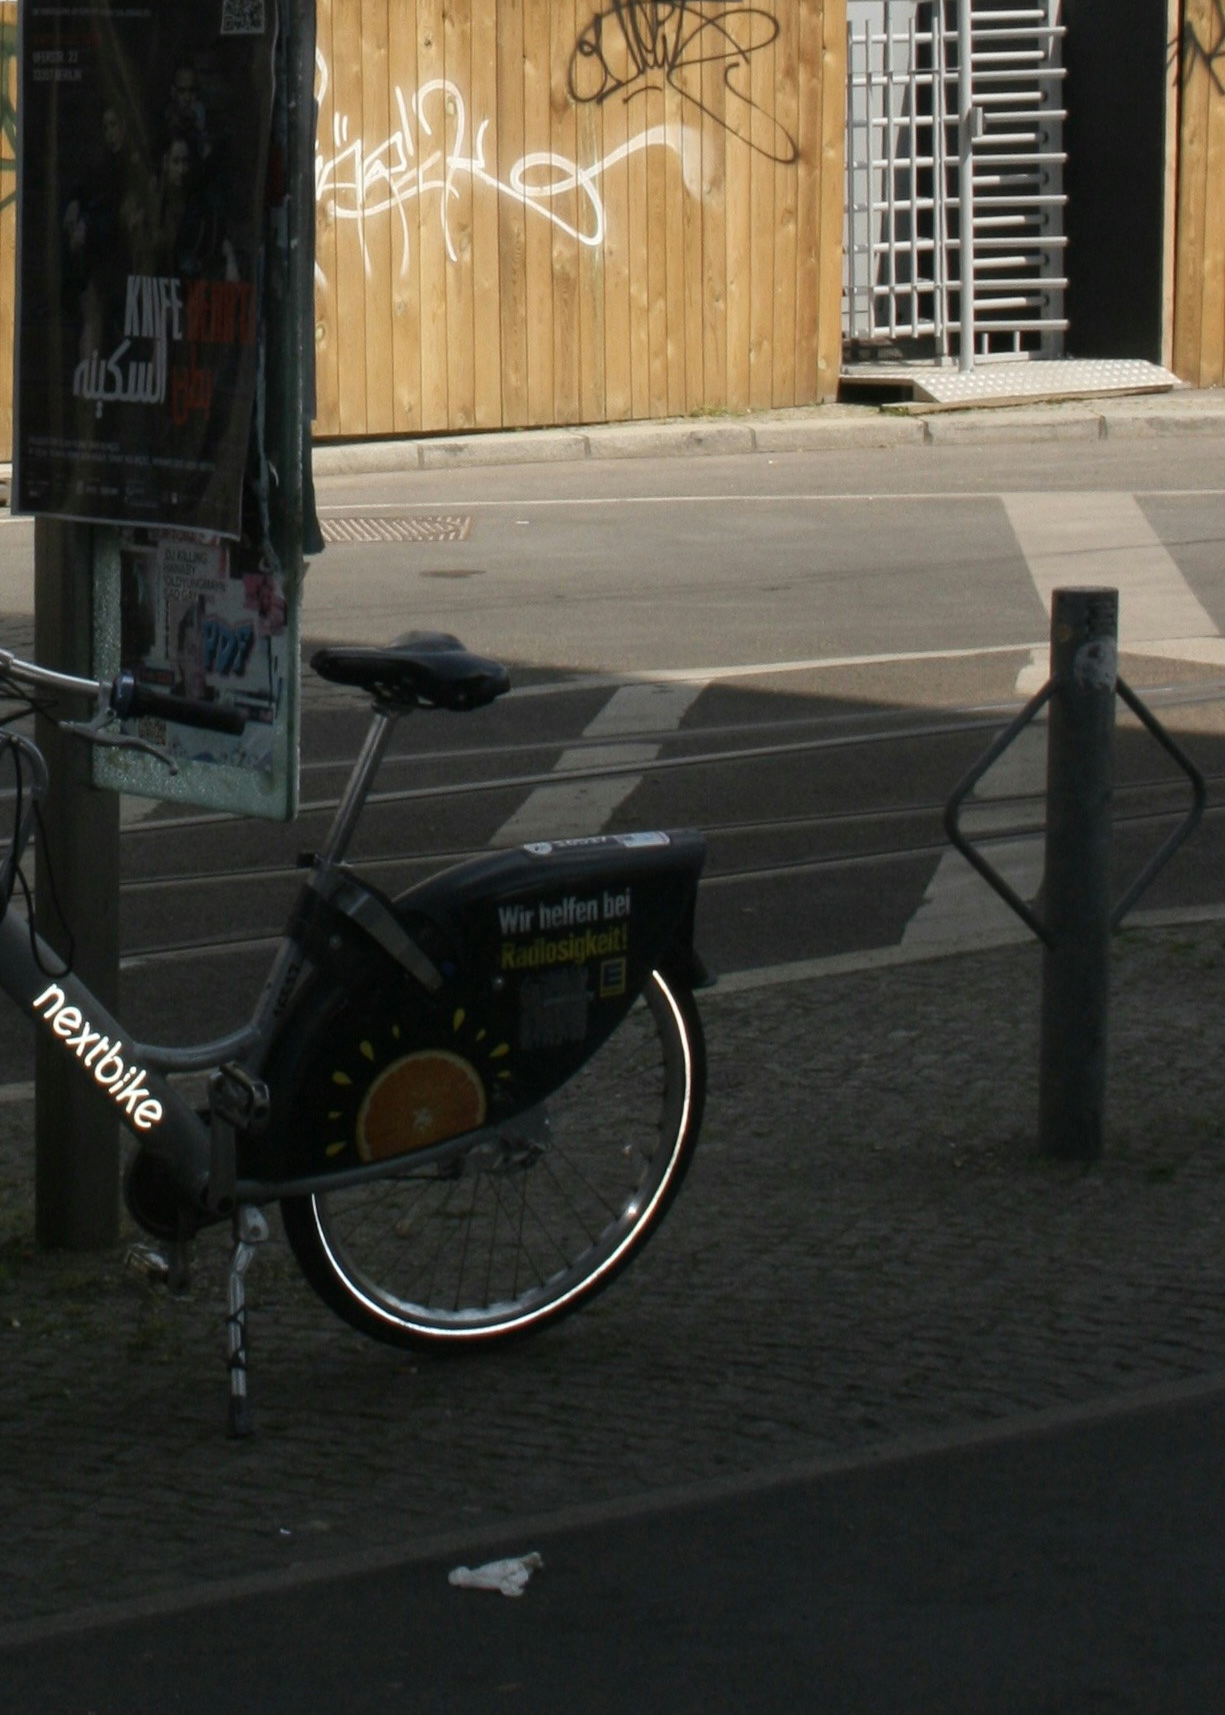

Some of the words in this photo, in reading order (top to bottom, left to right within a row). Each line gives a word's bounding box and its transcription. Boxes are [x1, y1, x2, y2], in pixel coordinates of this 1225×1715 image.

[124, 275, 183, 340] KNIFE
[499, 905, 535, 934] Wir
[539, 895, 599, 931] helfen
[603, 886, 632, 918] bei
[501, 924, 628, 970] Radlosigkeit!
[32, 982, 163, 1128] nextbike
